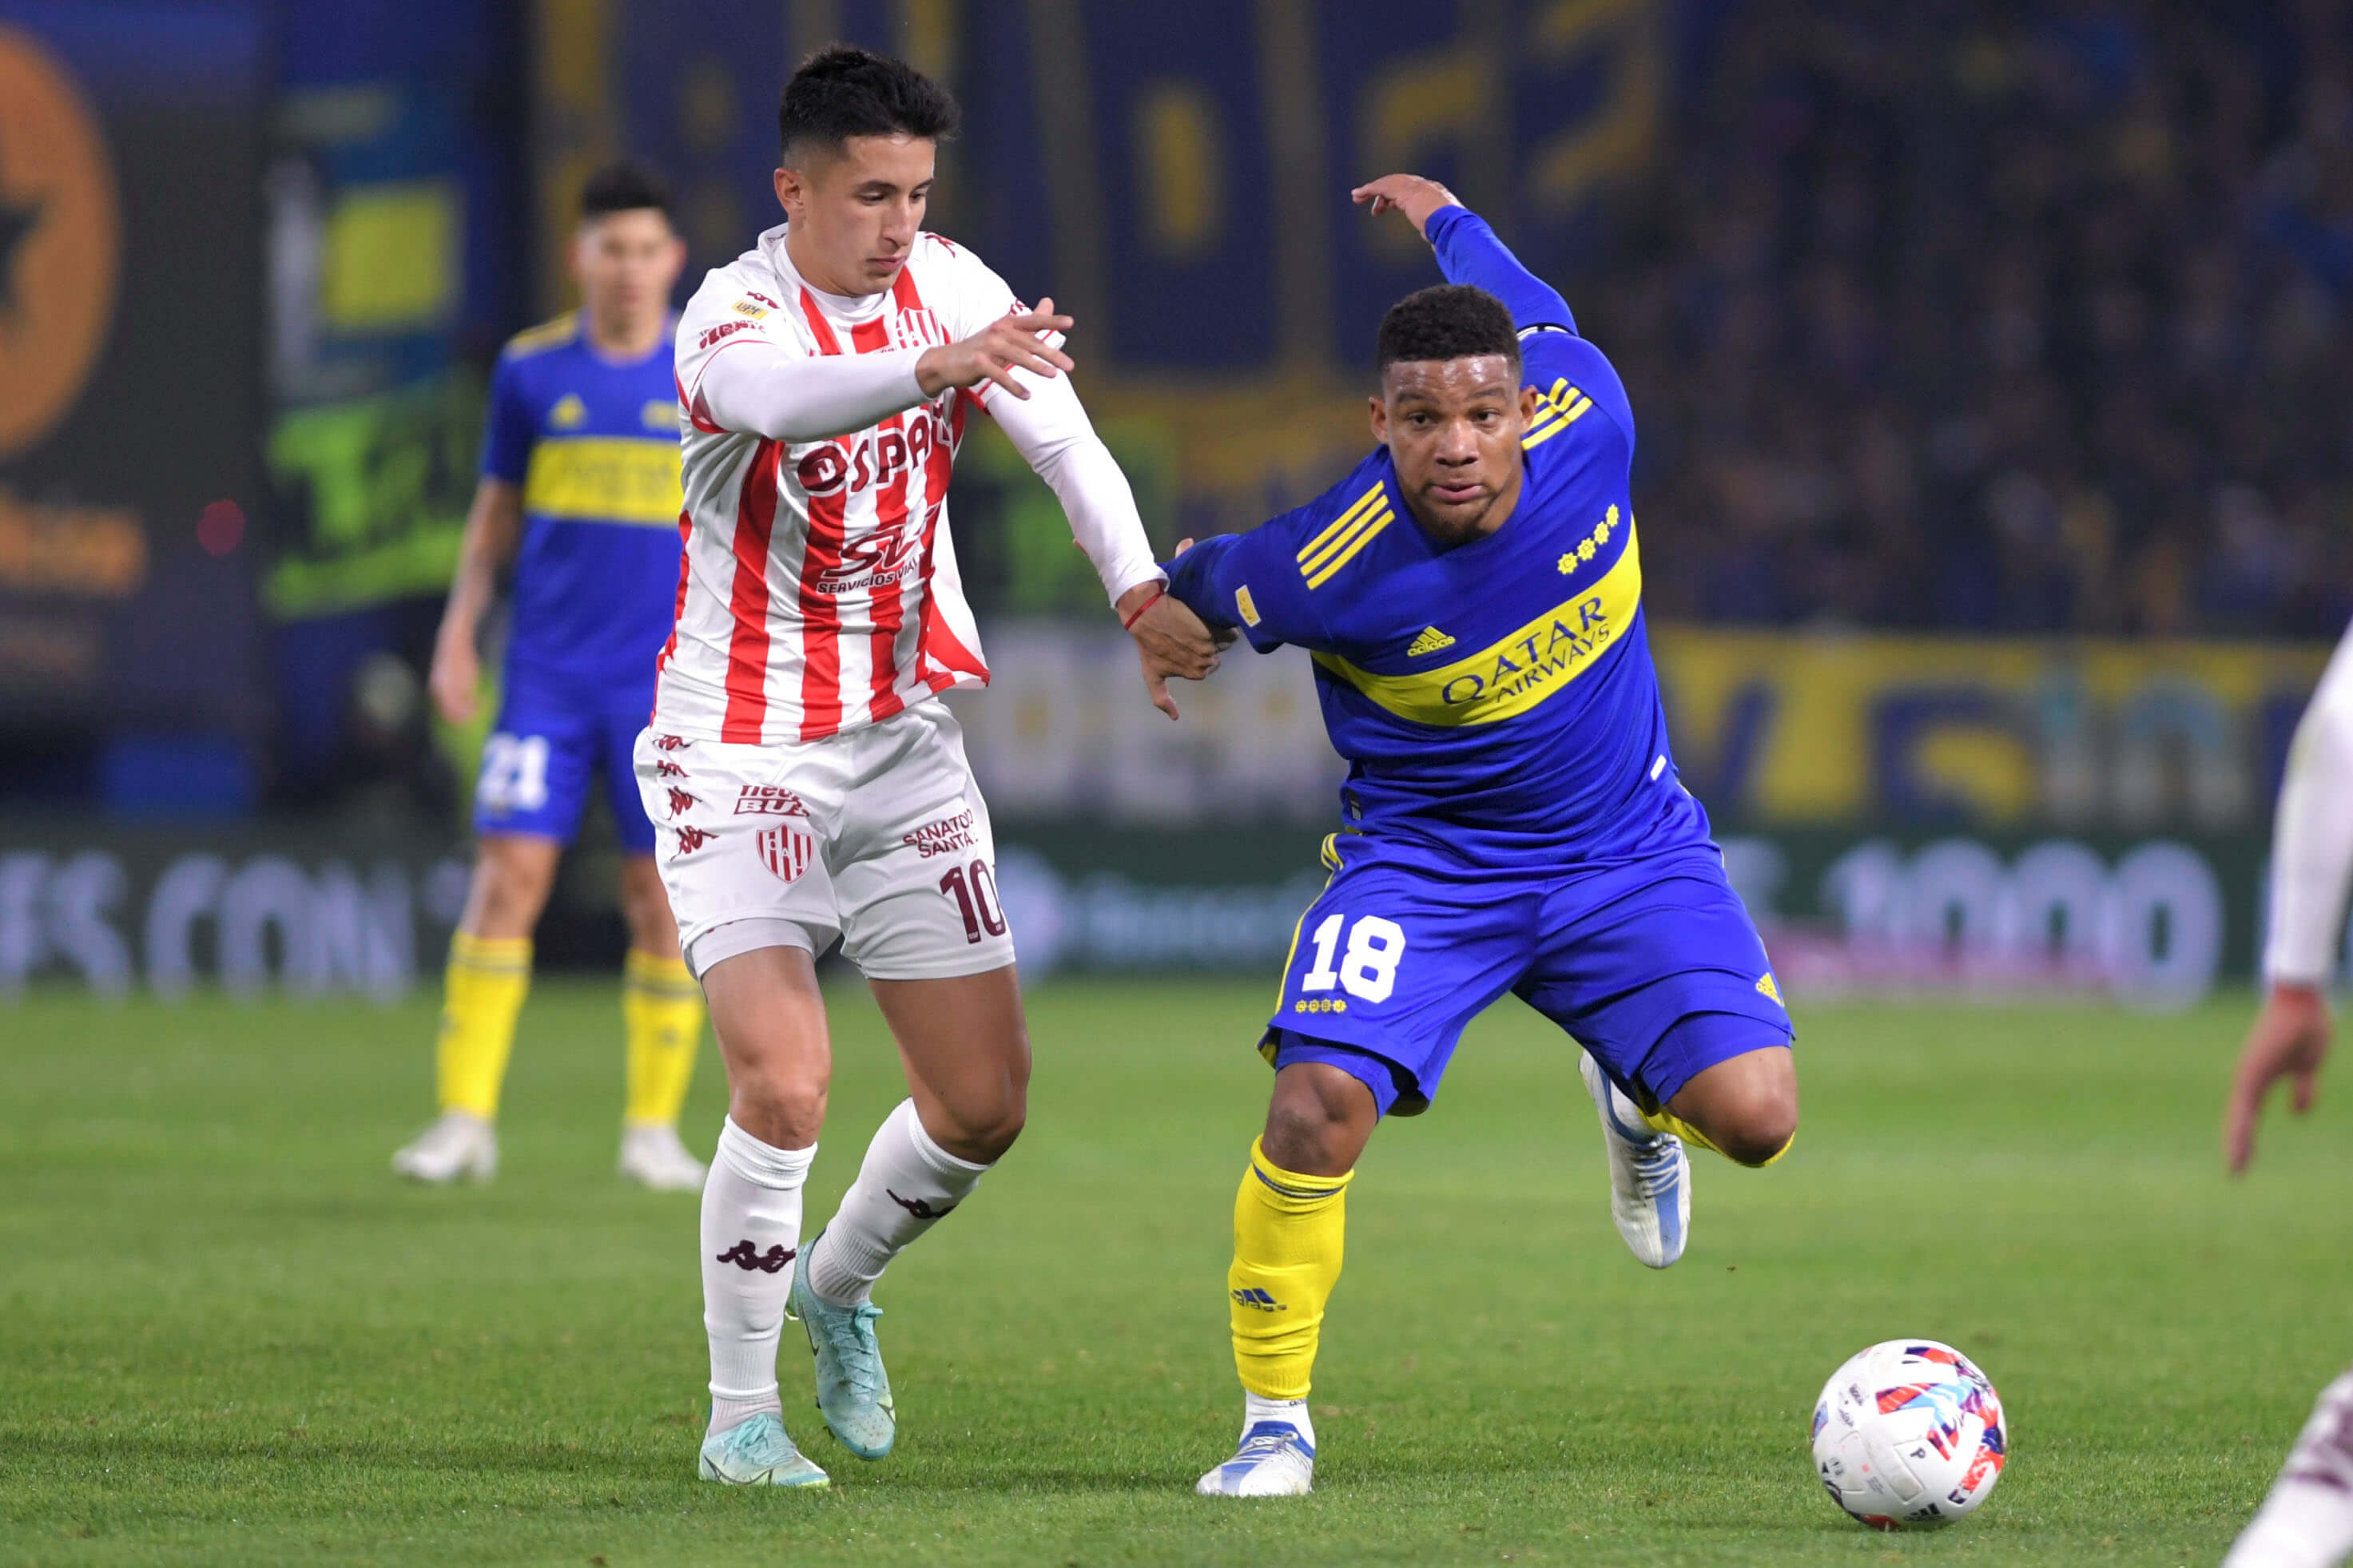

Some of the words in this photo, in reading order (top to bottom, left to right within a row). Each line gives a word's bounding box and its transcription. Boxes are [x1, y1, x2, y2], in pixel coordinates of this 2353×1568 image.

[817, 573, 893, 594] SERVICIOS
[1407, 636, 1456, 657] adidas
[1441, 597, 1607, 705] QATAR
[1496, 623, 1611, 703] AIRWAYS
[475, 732, 549, 811] 21
[918, 831, 974, 859] SANTA
[939, 859, 1007, 944] 10
[1818, 837, 2224, 1016] 1000
[1302, 913, 1407, 1004] 18
